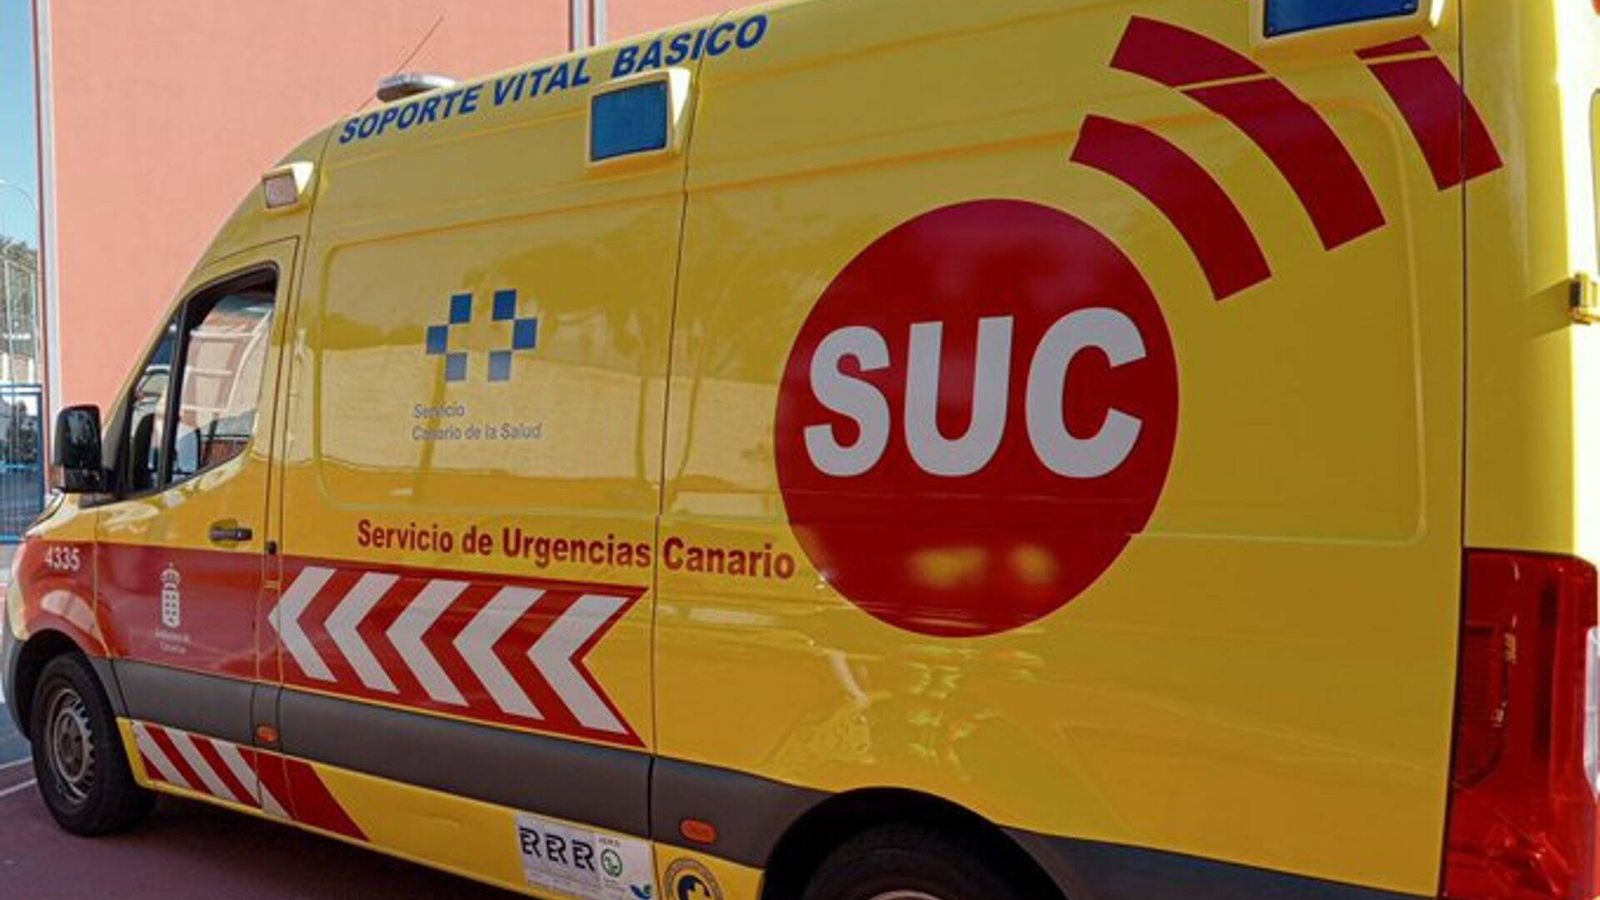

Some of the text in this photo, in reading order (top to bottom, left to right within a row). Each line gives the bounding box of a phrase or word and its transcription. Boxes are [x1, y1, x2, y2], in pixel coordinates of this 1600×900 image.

[339, 14, 768, 144] SOPORTE VITAL BÁSICO
[414, 403, 465, 419] Servicio
[804, 307, 1147, 478] SUC
[412, 422, 543, 440] Canario de la Salud
[44, 546, 81, 572] 4335
[357, 519, 796, 580] Servicio de Urgencias Canario
